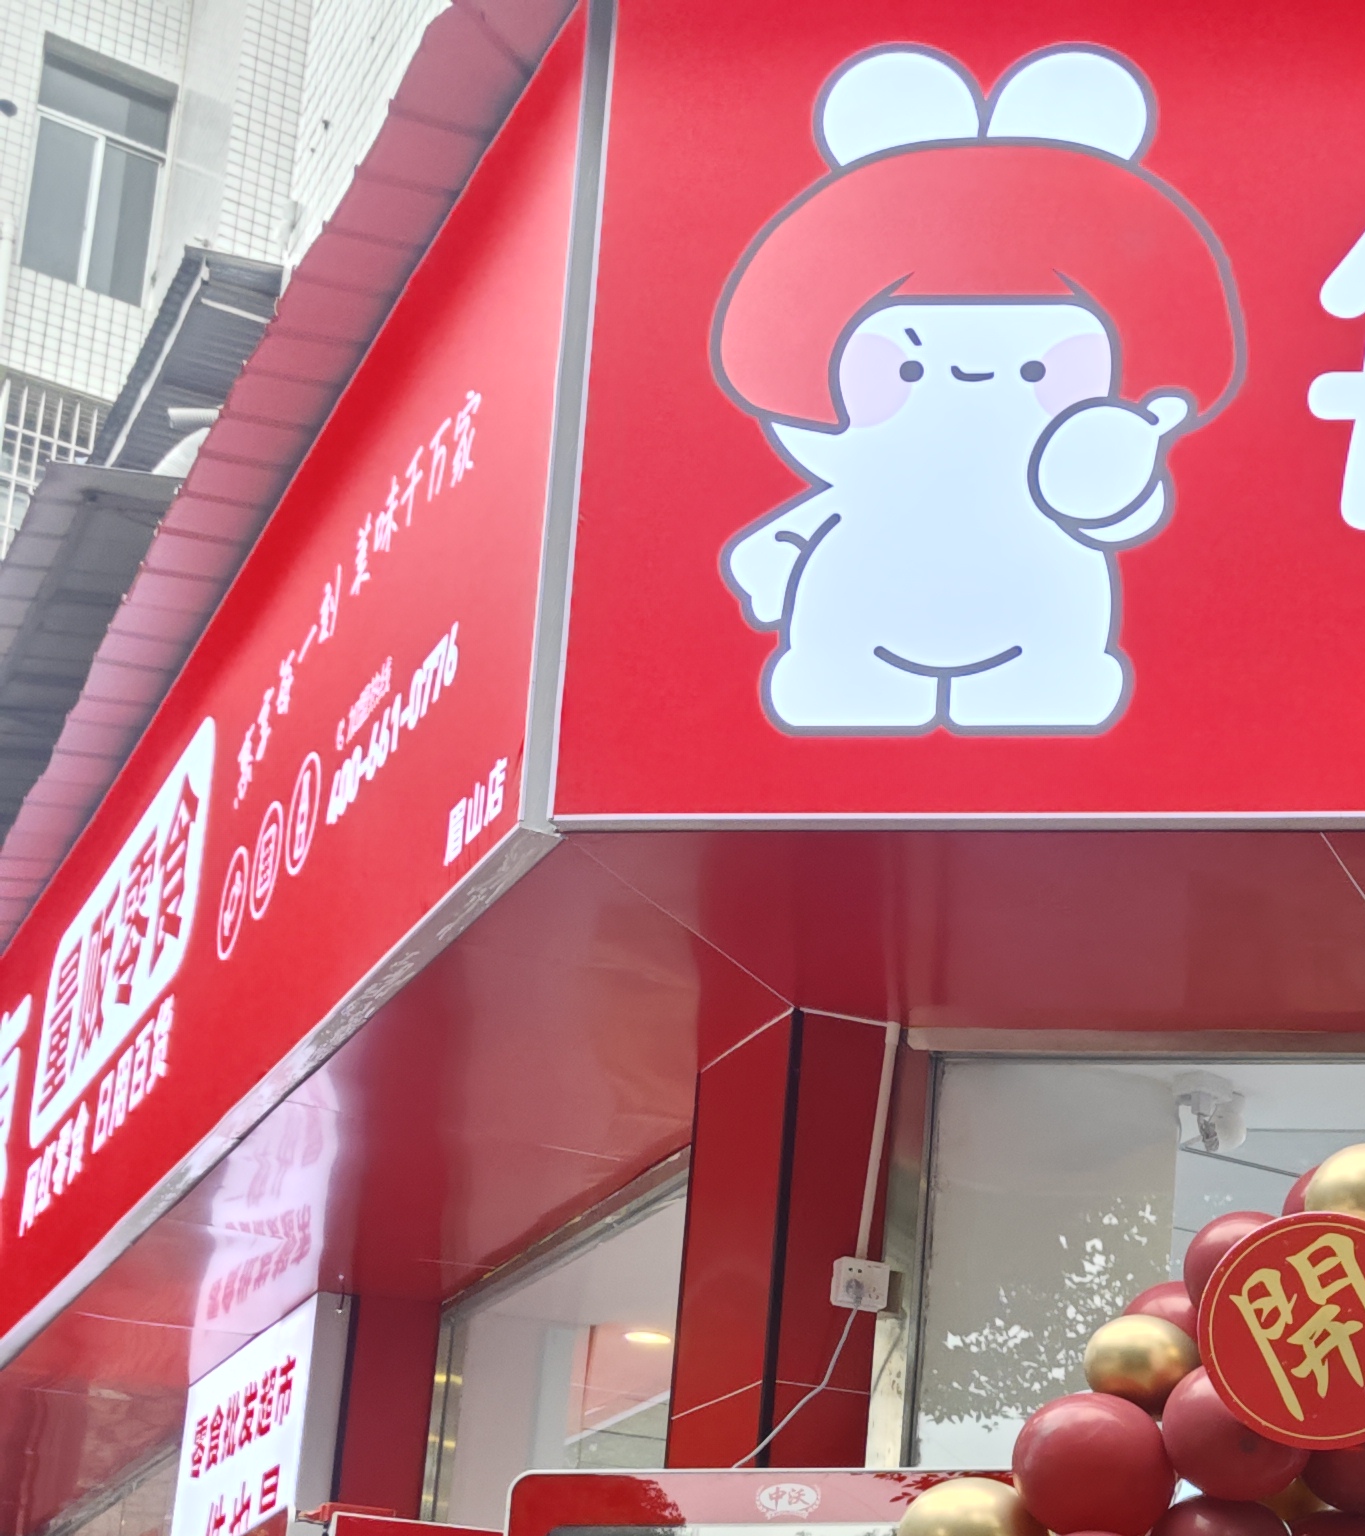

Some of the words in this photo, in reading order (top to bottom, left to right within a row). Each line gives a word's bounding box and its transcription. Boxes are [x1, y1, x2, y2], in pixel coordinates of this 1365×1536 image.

[444, 757, 508, 867] 眉山店
[36, 773, 199, 1119] 量贩零食
[92, 993, 175, 1154] 日用百货
[191, 1355, 296, 1478] 零食批发超市
